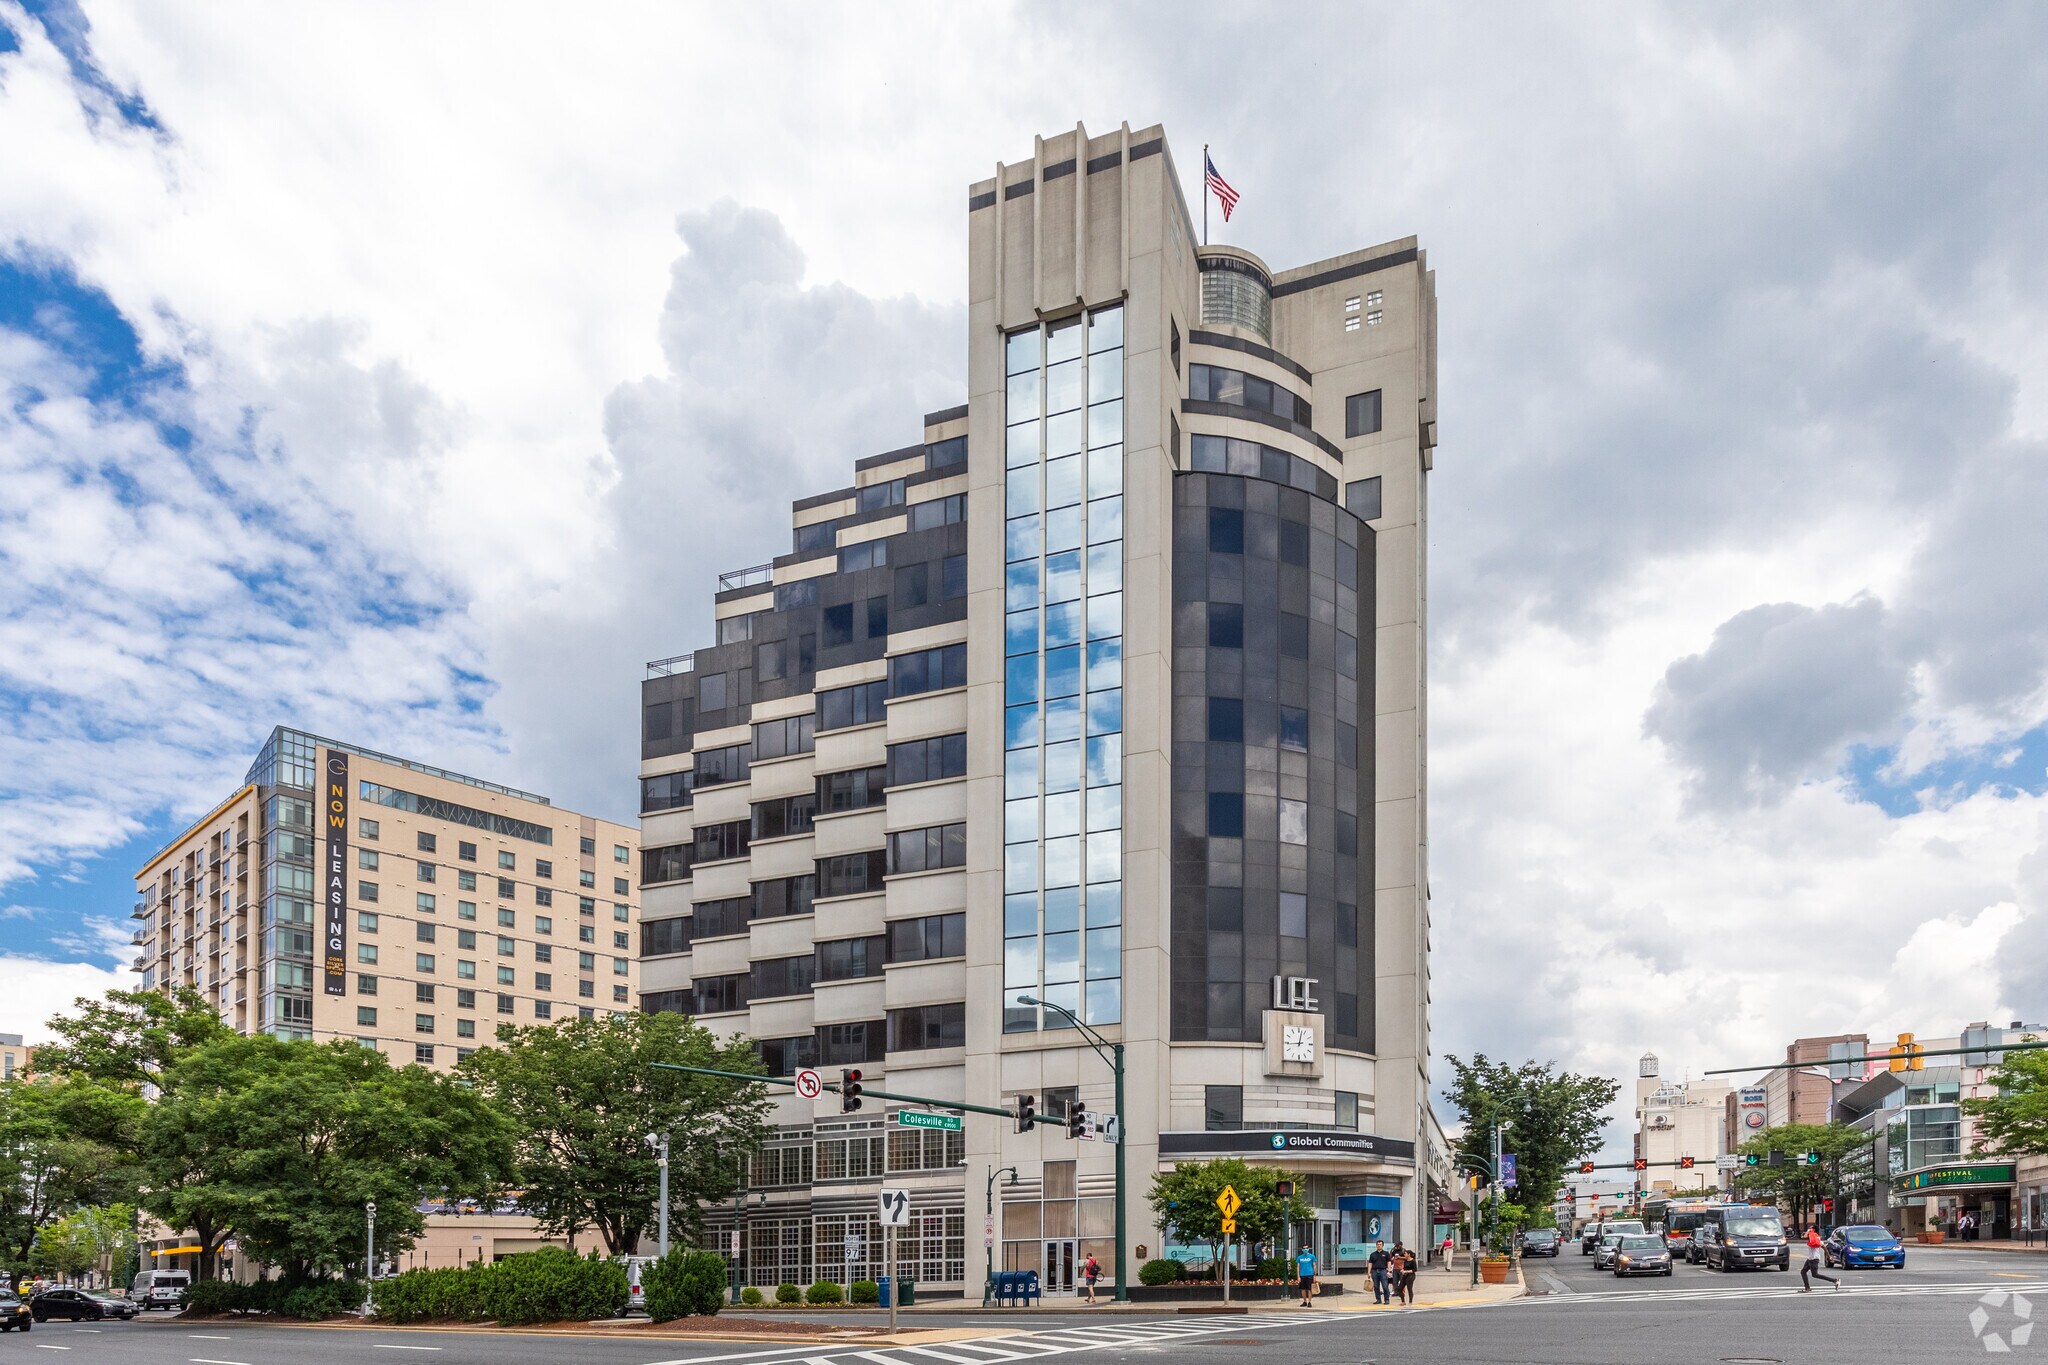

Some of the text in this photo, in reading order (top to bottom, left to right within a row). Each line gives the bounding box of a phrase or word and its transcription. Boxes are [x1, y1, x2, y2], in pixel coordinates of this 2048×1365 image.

[329, 784, 345, 950] NOW LEASING
[1273, 975, 1319, 1011] LEE
[904, 1113, 943, 1127] Colesville
[1105, 1134, 1118, 1142] ONLY
[1289, 1136, 1374, 1149] Global Communities
[845, 1249, 858, 1258] 97
